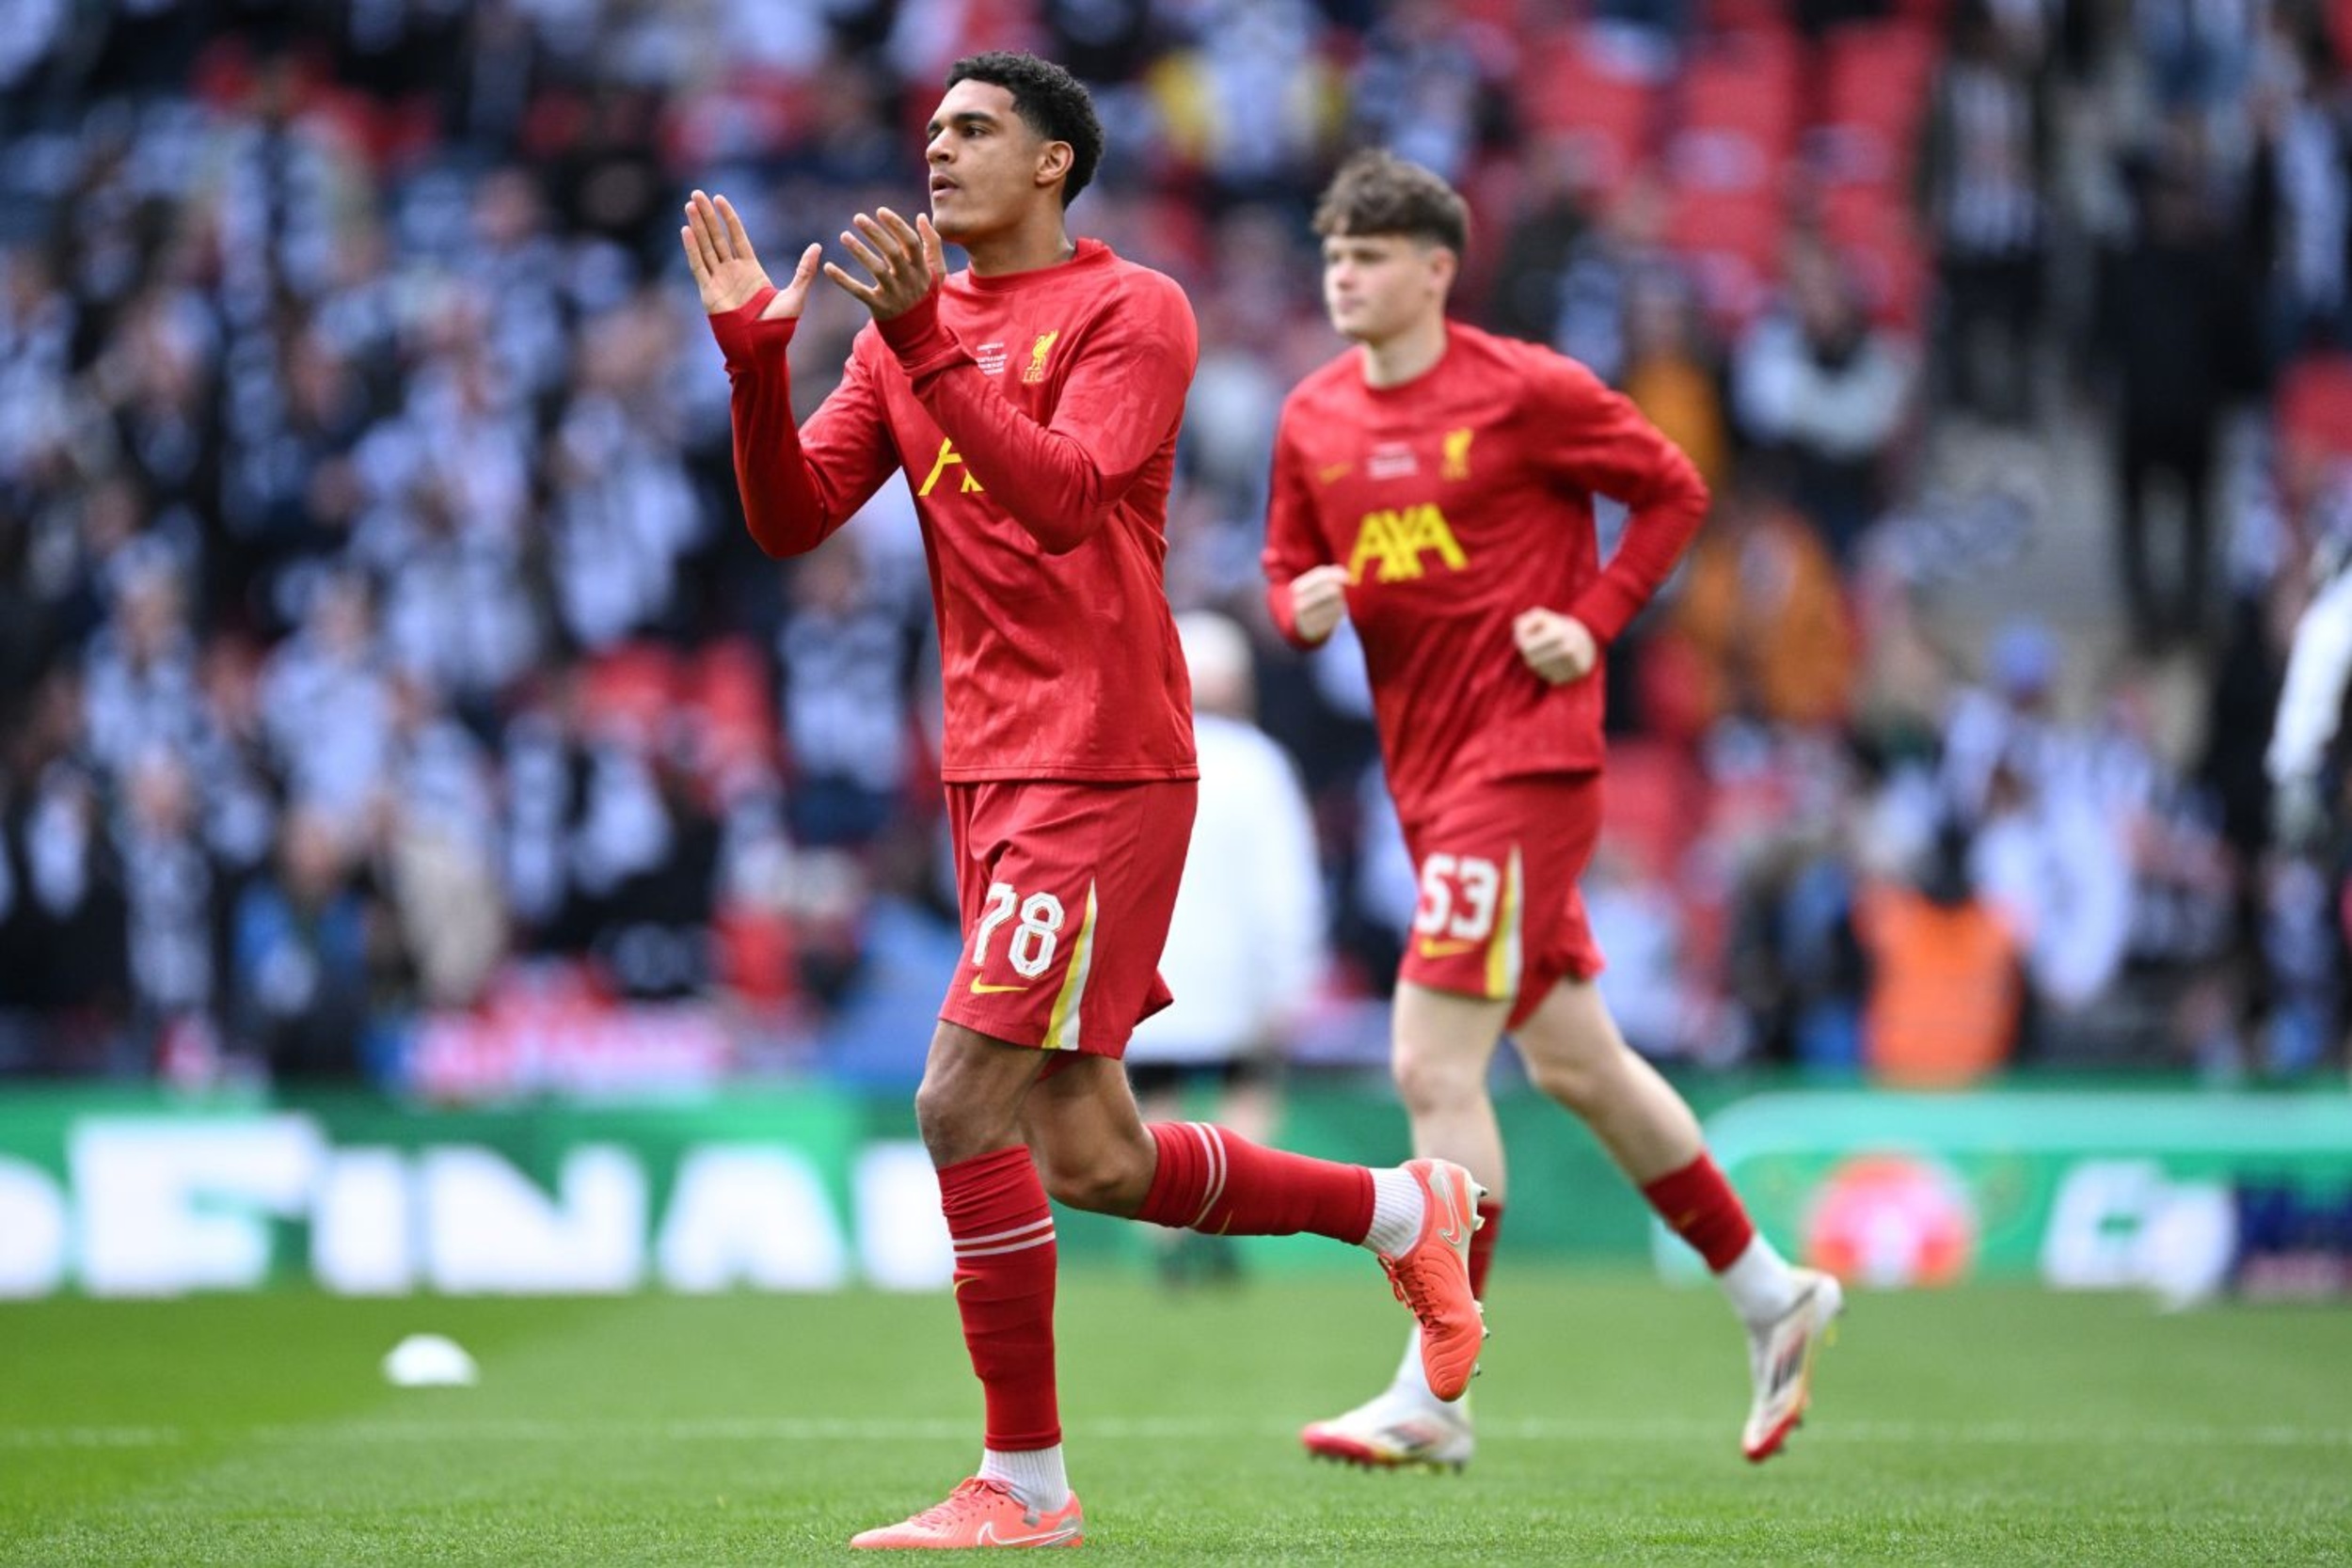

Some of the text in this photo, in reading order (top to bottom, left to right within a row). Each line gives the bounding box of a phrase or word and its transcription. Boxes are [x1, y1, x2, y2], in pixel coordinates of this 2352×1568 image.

[1349, 503, 1468, 585] AXA
[972, 881, 1065, 980] 78
[1415, 853, 1500, 942] 53
